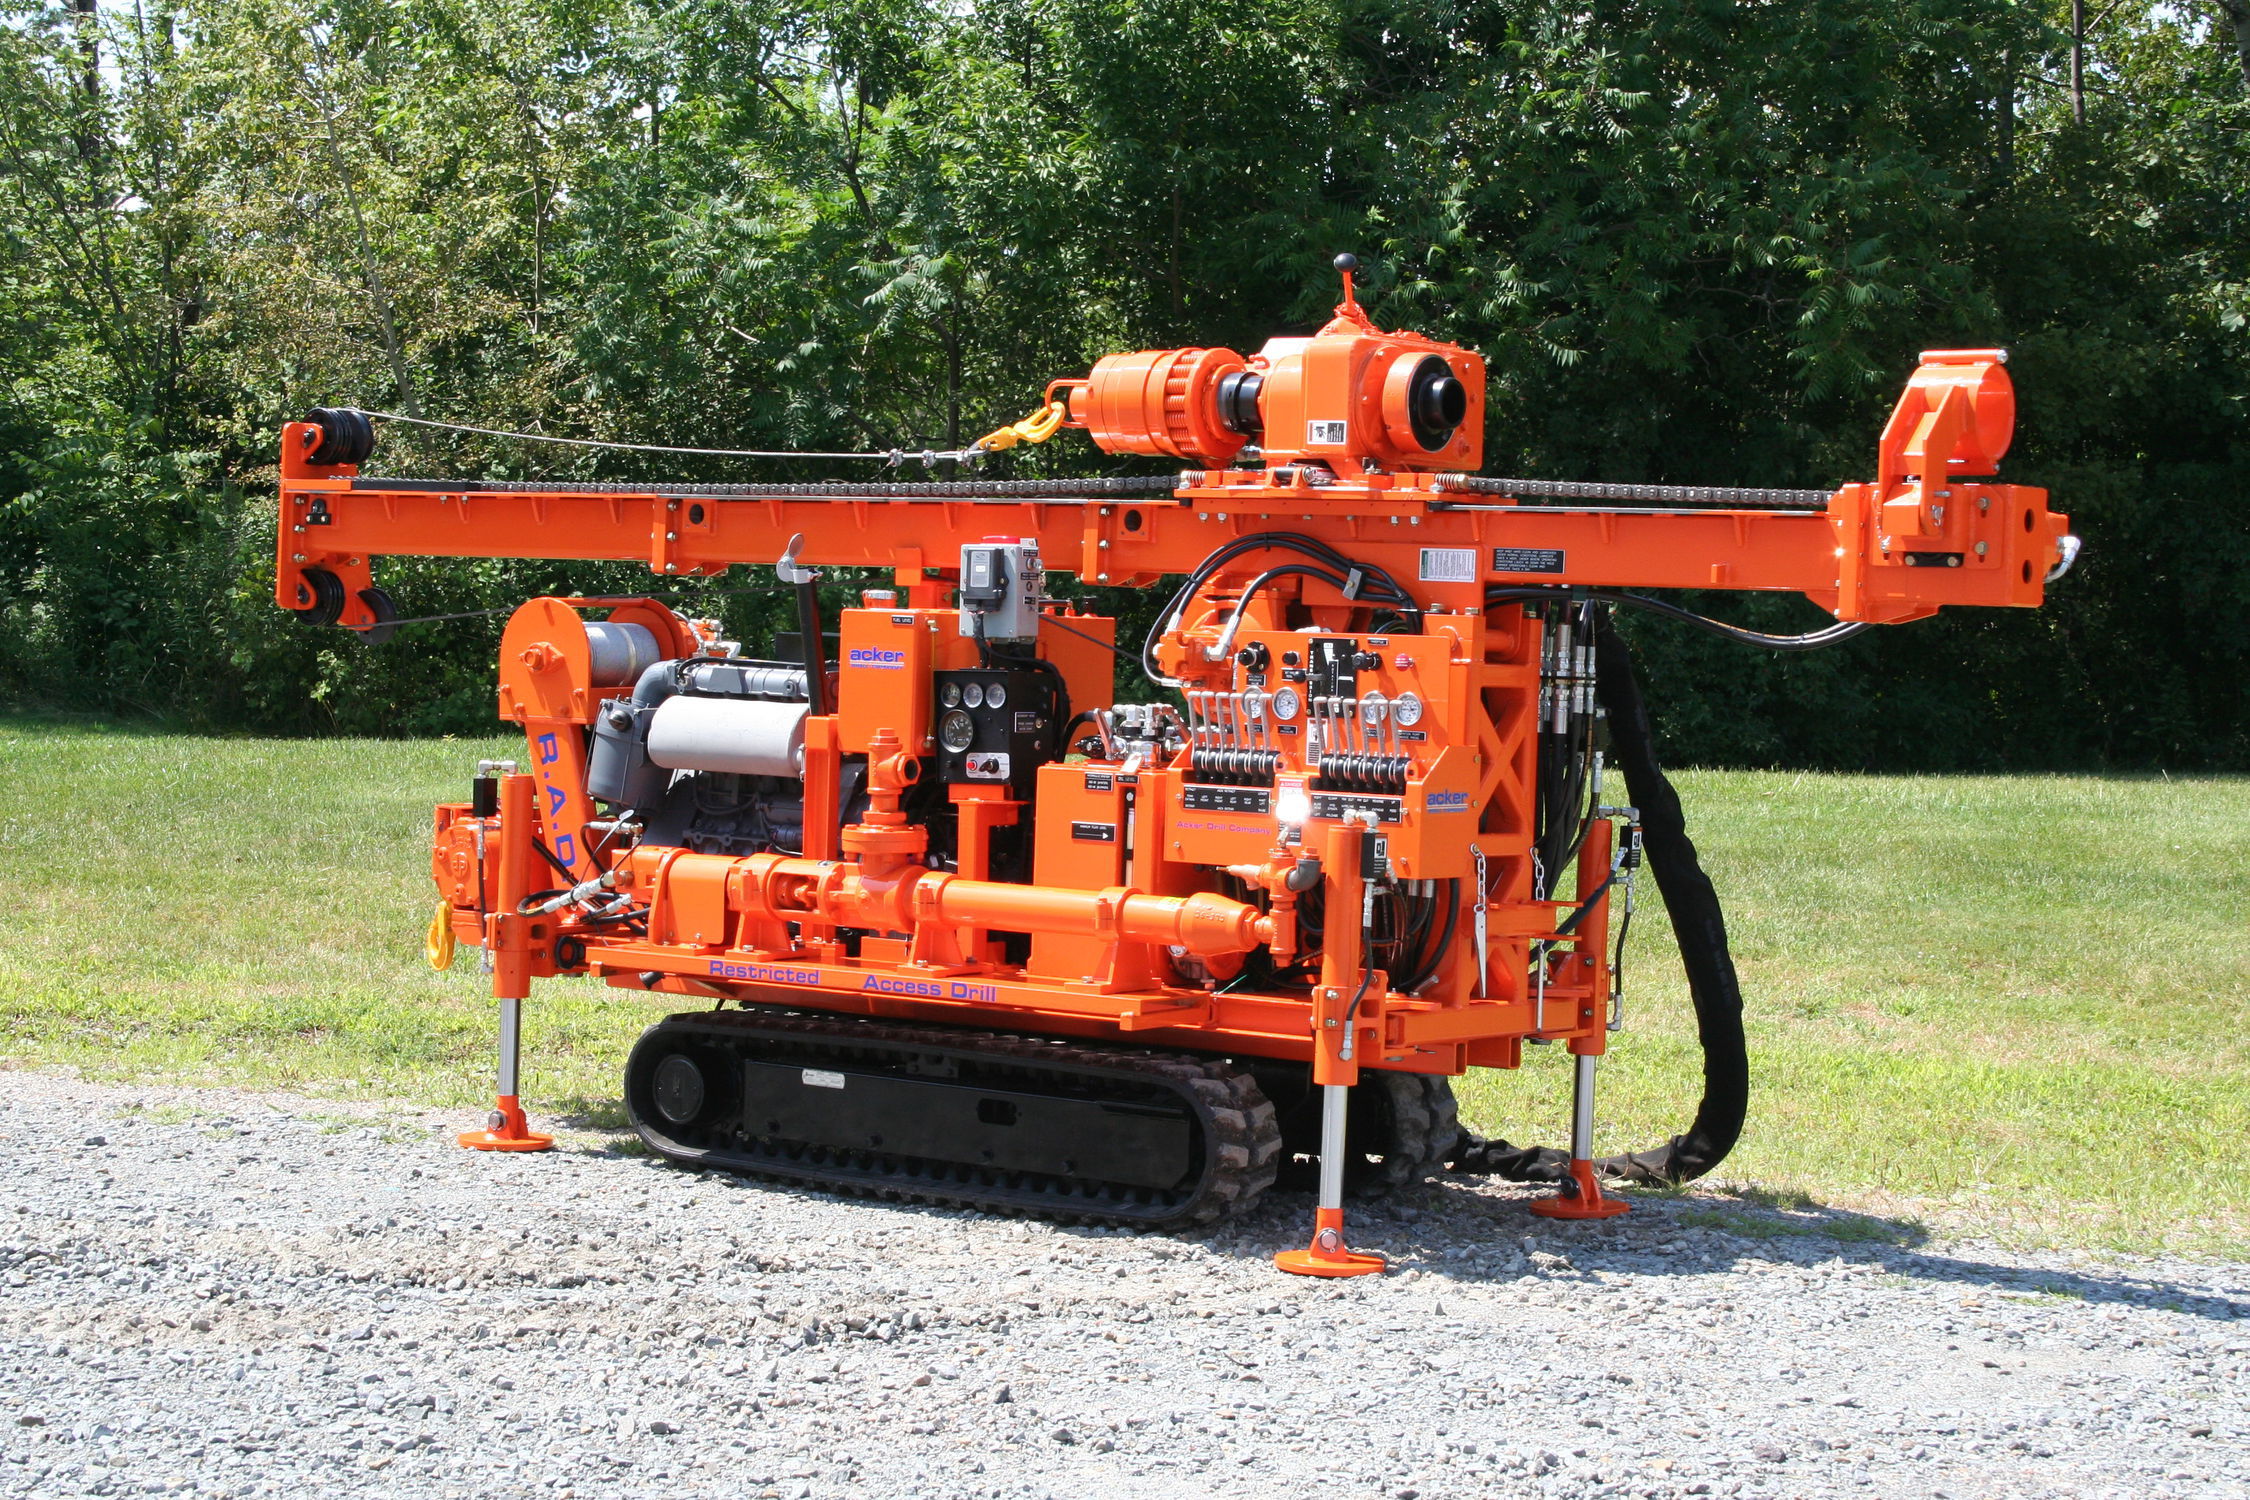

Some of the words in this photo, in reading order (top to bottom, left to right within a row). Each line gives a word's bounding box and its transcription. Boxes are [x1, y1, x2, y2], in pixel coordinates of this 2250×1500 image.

[850, 647, 904, 662] acker
[1427, 789, 1468, 805] acker
[1177, 821, 1203, 829] Acker
[1207, 822, 1226, 831] Drill
[1229, 824, 1270, 835] Company
[709, 960, 820, 985] Restricted
[863, 975, 941, 996] Access
[951, 983, 996, 1002] Drill
